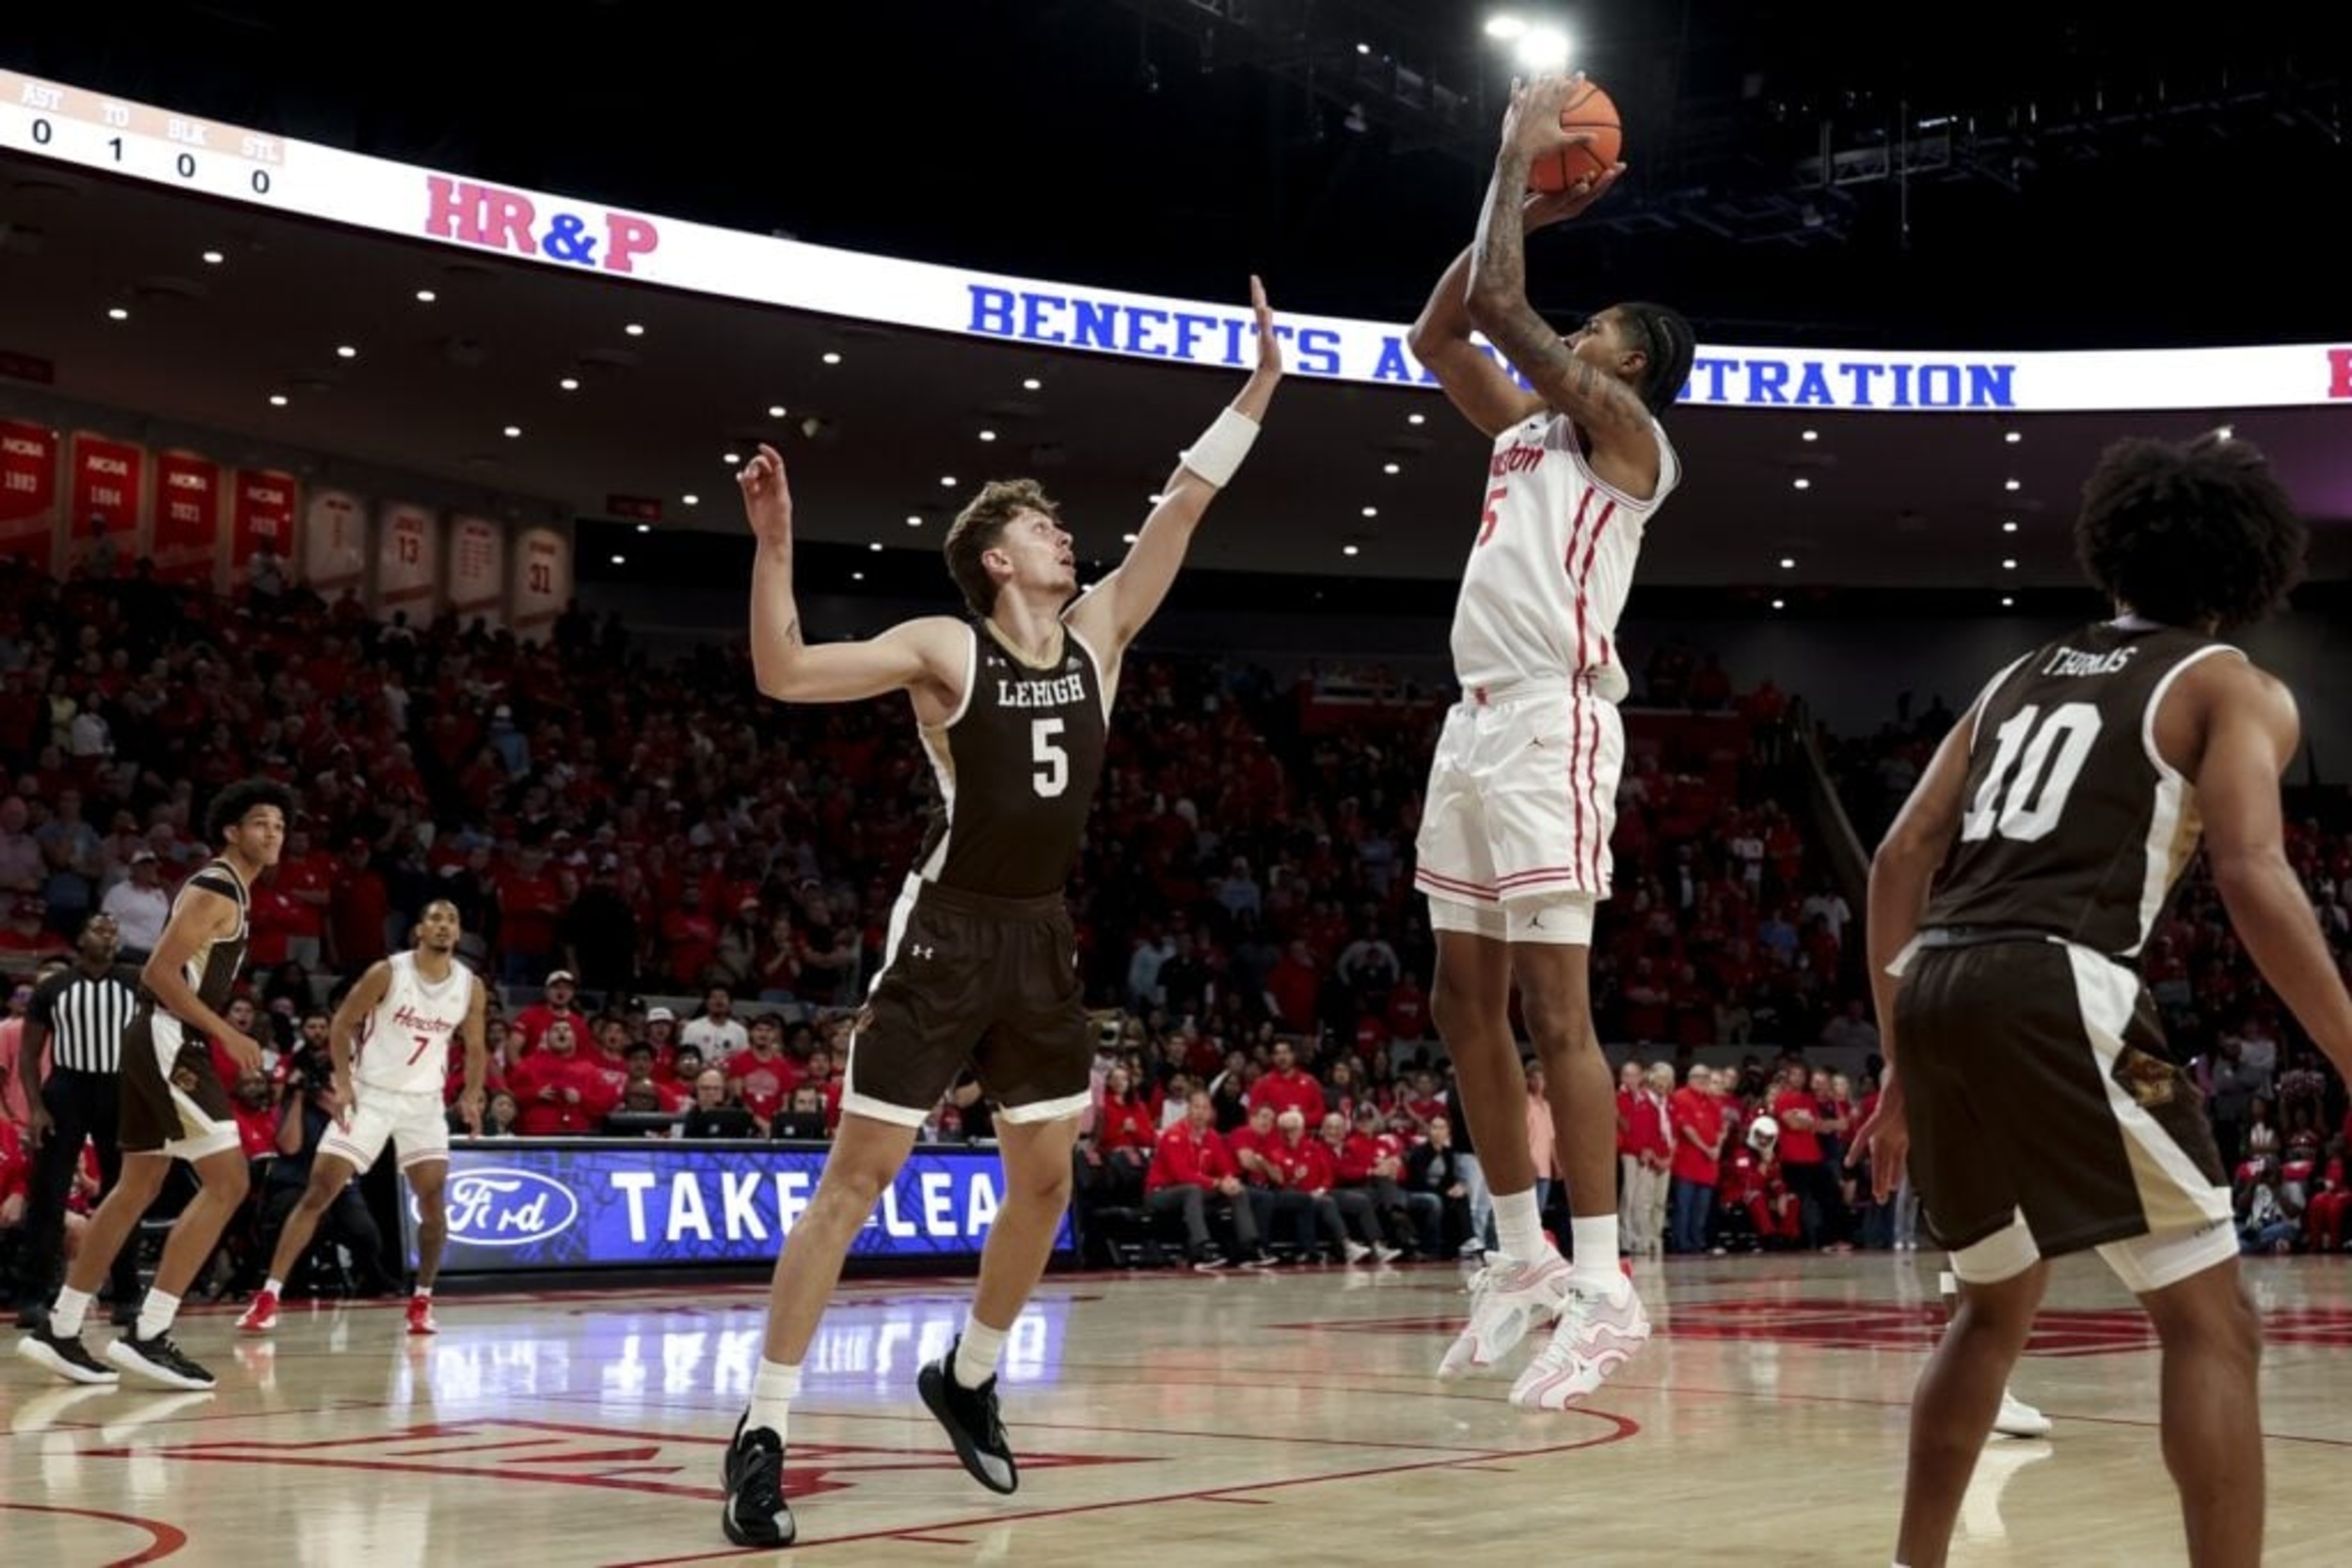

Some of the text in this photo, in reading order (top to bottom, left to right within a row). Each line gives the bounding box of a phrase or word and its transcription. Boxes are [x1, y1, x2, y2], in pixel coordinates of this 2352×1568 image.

[21, 82, 279, 162] AST TO BLK STL
[31, 119, 271, 195] 0 1 0 0
[425, 175, 659, 273] HR&P
[399, 536, 420, 563] 13
[1479, 486, 1507, 547] 5
[998, 673, 1085, 706] LEHIGH
[1031, 718, 1069, 798] 5
[1961, 703, 2103, 842] 10
[407, 1036, 429, 1066] 7
[611, 1171, 810, 1243] TAKE
[882, 1173, 1003, 1237] LEA
